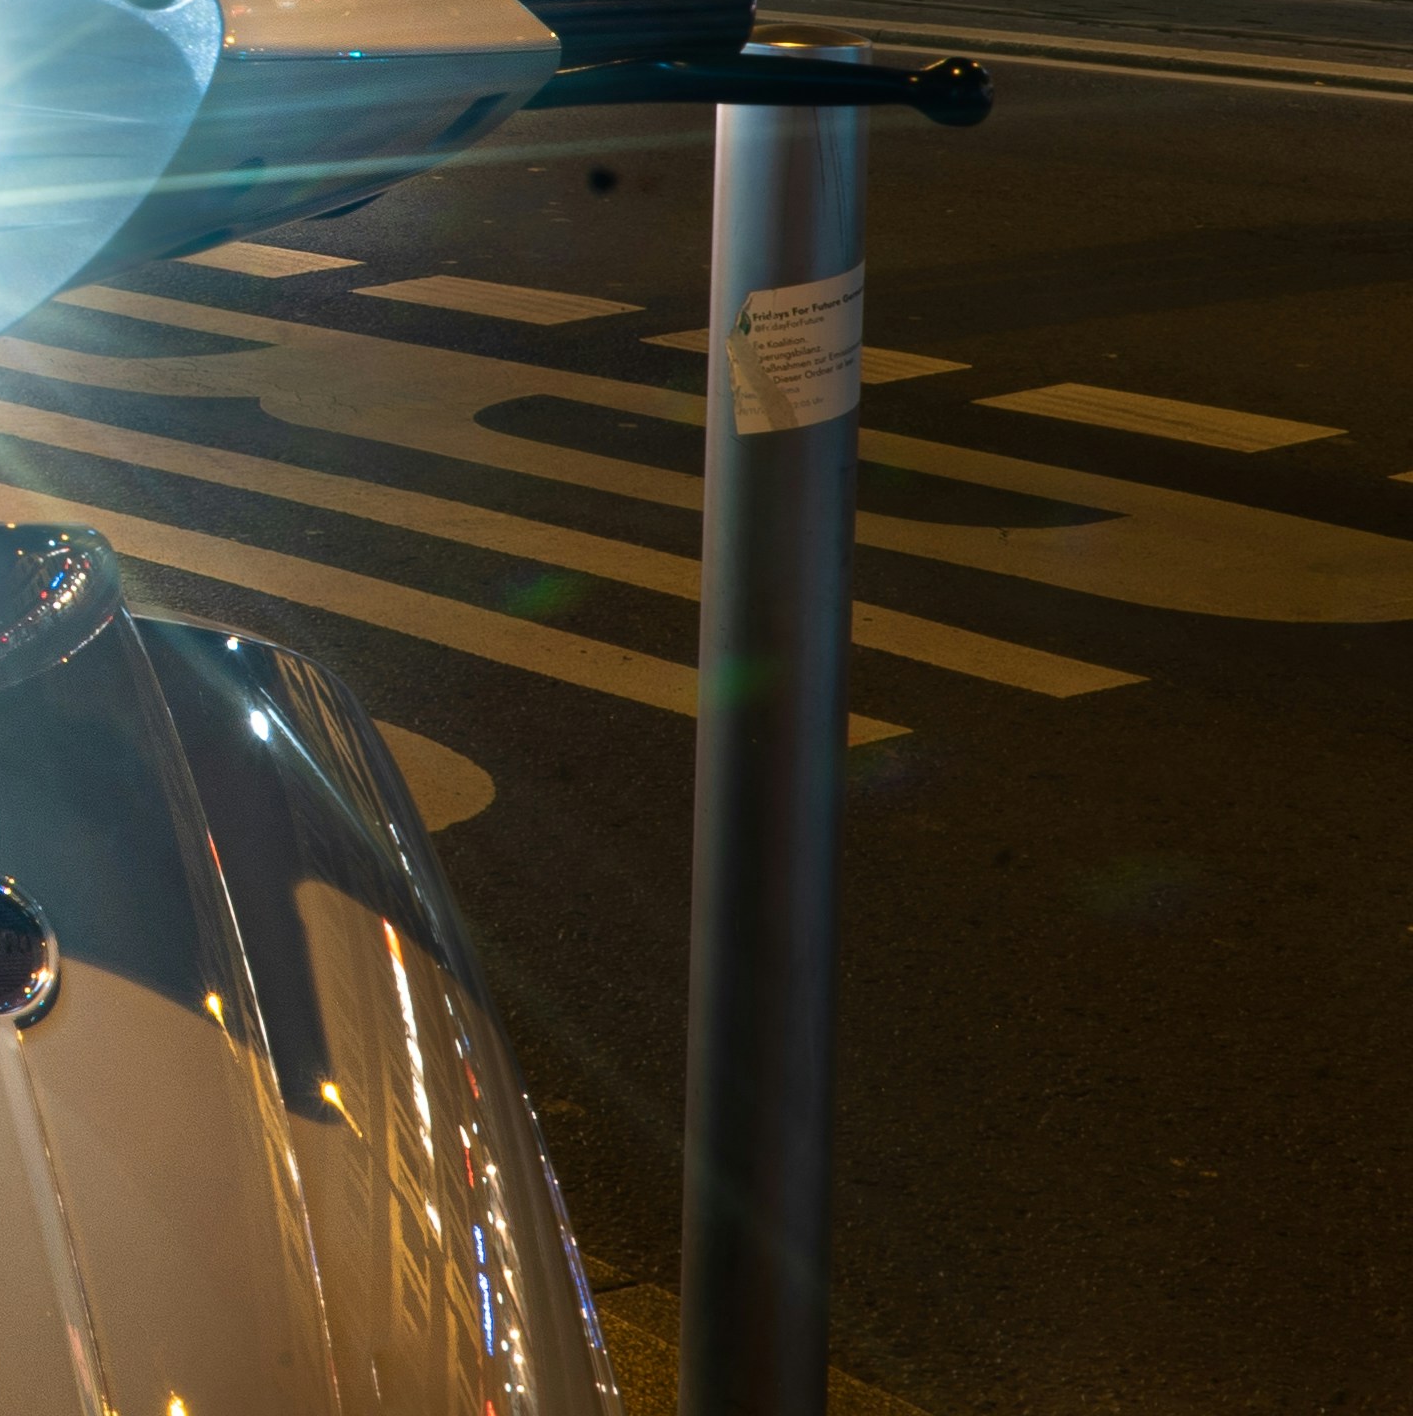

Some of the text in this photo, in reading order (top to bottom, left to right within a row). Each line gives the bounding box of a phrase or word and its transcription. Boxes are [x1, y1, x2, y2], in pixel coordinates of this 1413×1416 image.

[752, 310, 789, 322] Fridays
[792, 307, 810, 317] For
[812, 299, 841, 313] Future
[755, 315, 824, 333] @FrdayForFuture
[762, 360, 812, 373] aßnahmen
[814, 356, 827, 365] zur
[773, 374, 802, 385] Dieser
[805, 366, 834, 379] Ordner
